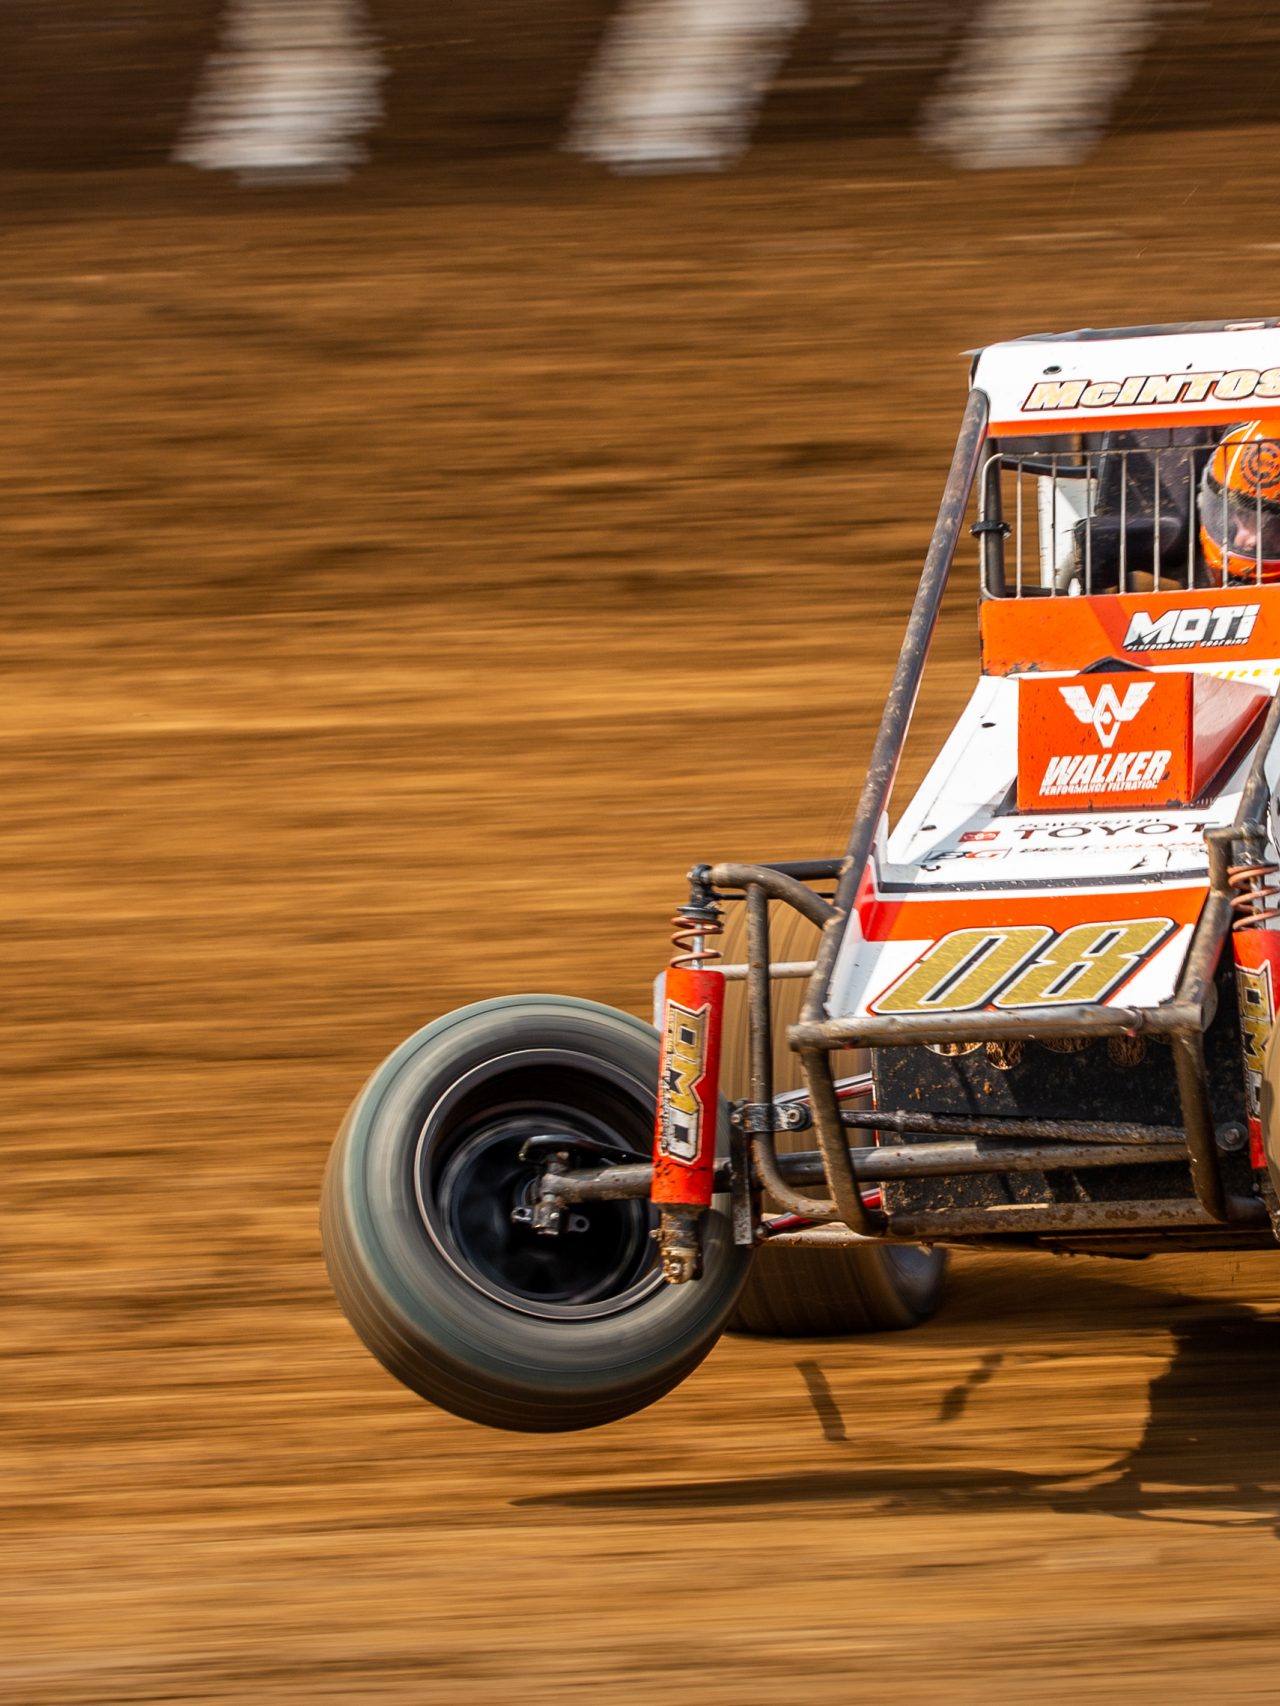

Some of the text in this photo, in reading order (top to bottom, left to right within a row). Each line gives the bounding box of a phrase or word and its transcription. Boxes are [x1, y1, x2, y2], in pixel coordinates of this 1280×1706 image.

[1042, 751, 1171, 786] WALKER
[1039, 781, 1107, 797] PERFORMANCE
[1014, 820, 1221, 842] TOYOT
[870, 916, 1180, 1016] 08
